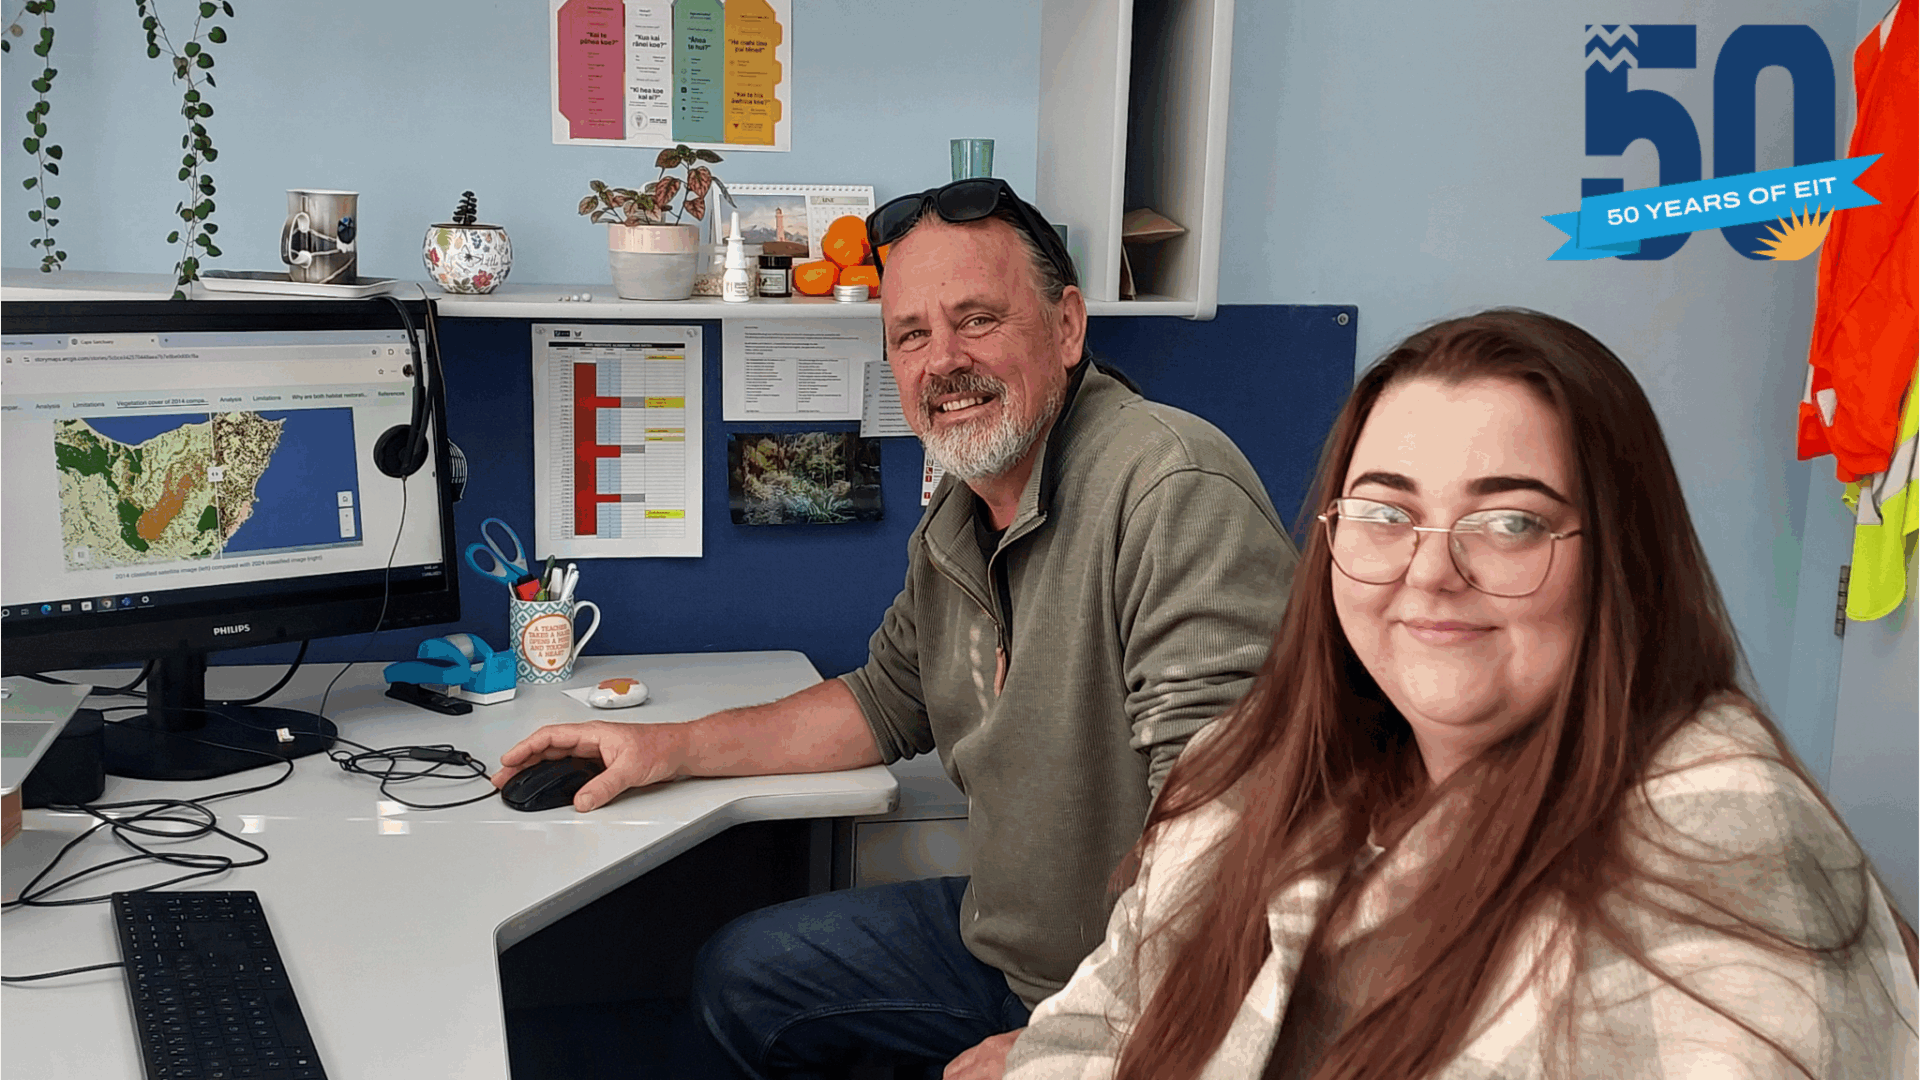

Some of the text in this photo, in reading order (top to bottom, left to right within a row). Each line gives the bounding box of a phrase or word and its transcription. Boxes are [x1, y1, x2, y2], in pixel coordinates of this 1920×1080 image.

[220, 393, 281, 404] Analysis Limitations
[35, 402, 60, 411] Analysis
[73, 401, 105, 409] Limitations
[213, 624, 251, 636] PHILIPS
